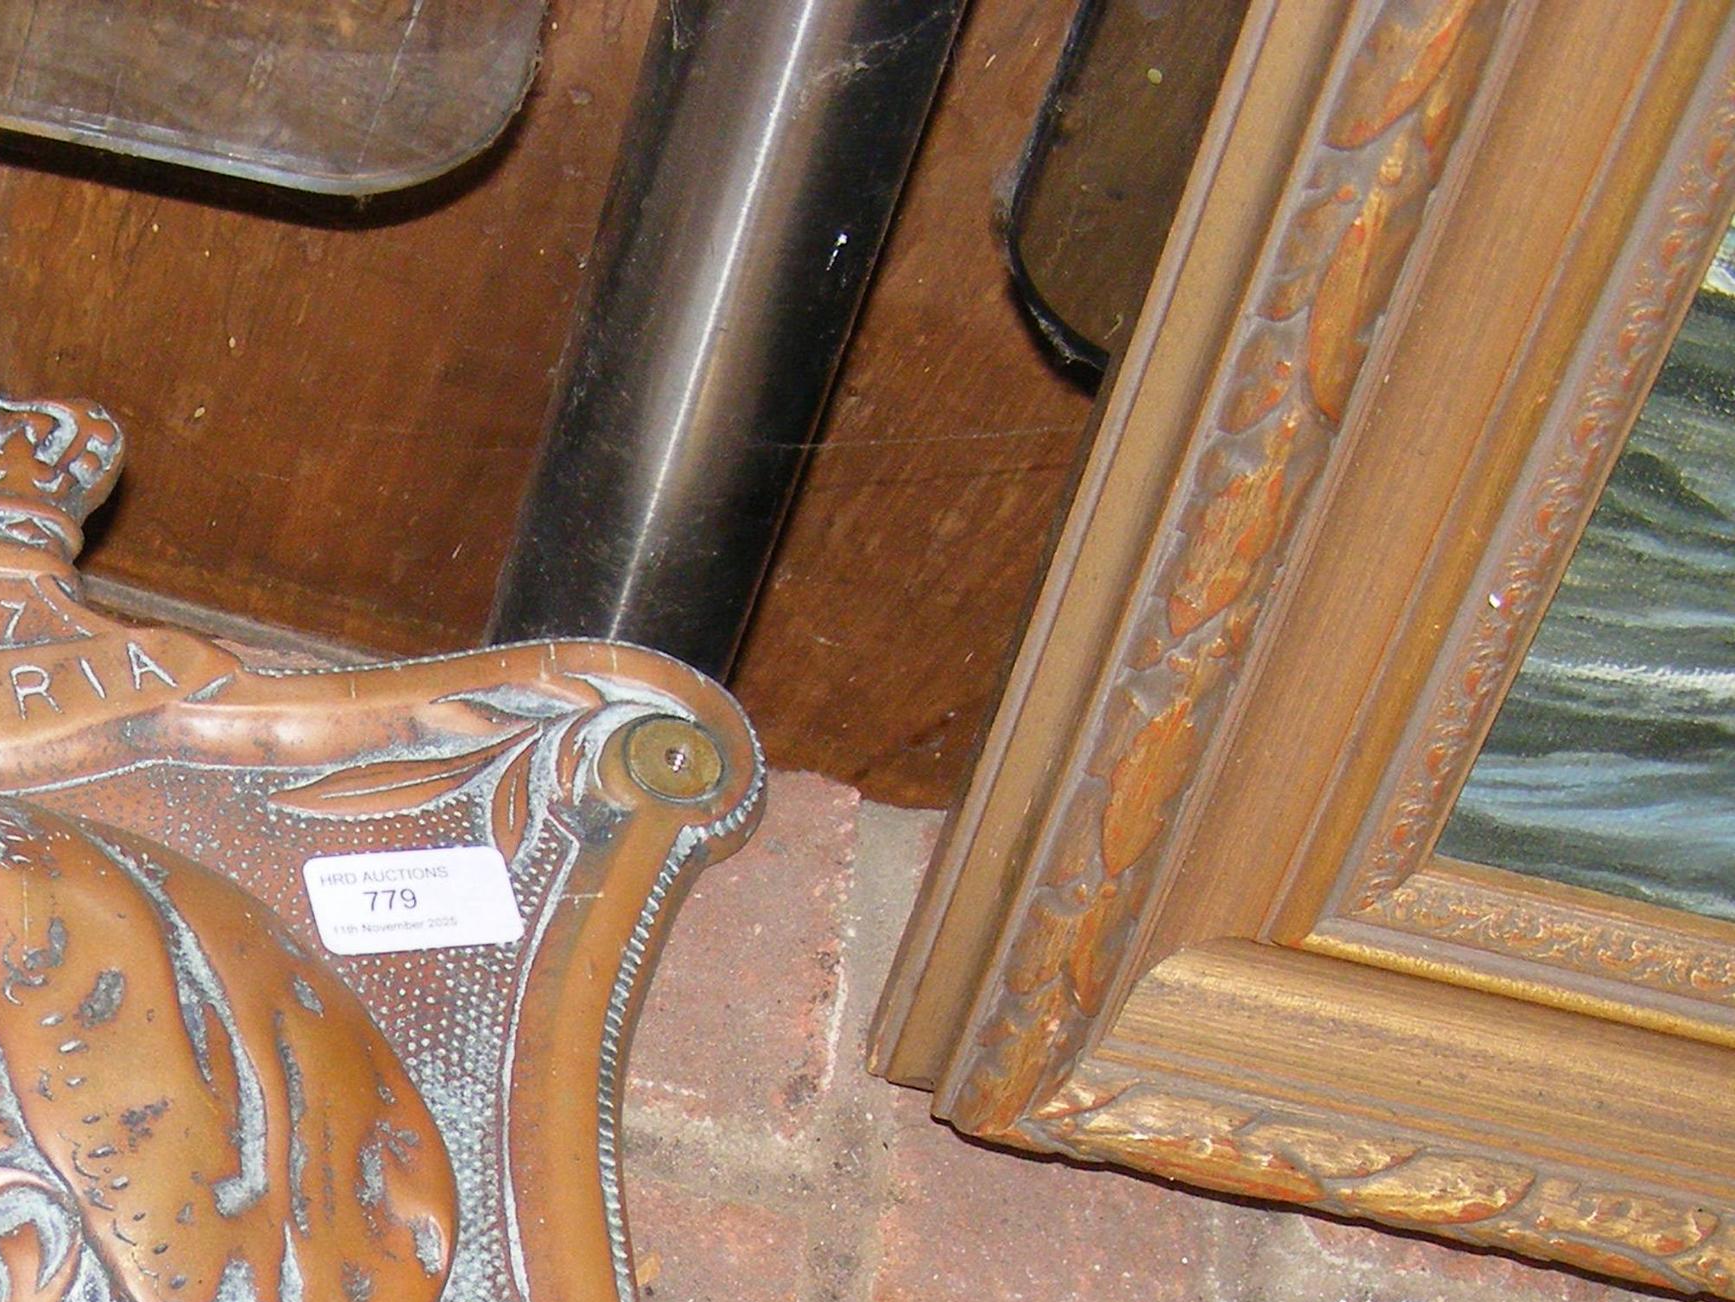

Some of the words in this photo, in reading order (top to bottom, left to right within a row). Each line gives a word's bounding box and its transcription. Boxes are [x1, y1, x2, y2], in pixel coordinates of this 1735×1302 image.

[319, 871, 358, 887] HRD
[362, 865, 449, 883] AUCTIONS
[362, 887, 418, 912] 779
[361, 918, 425, 934] November
